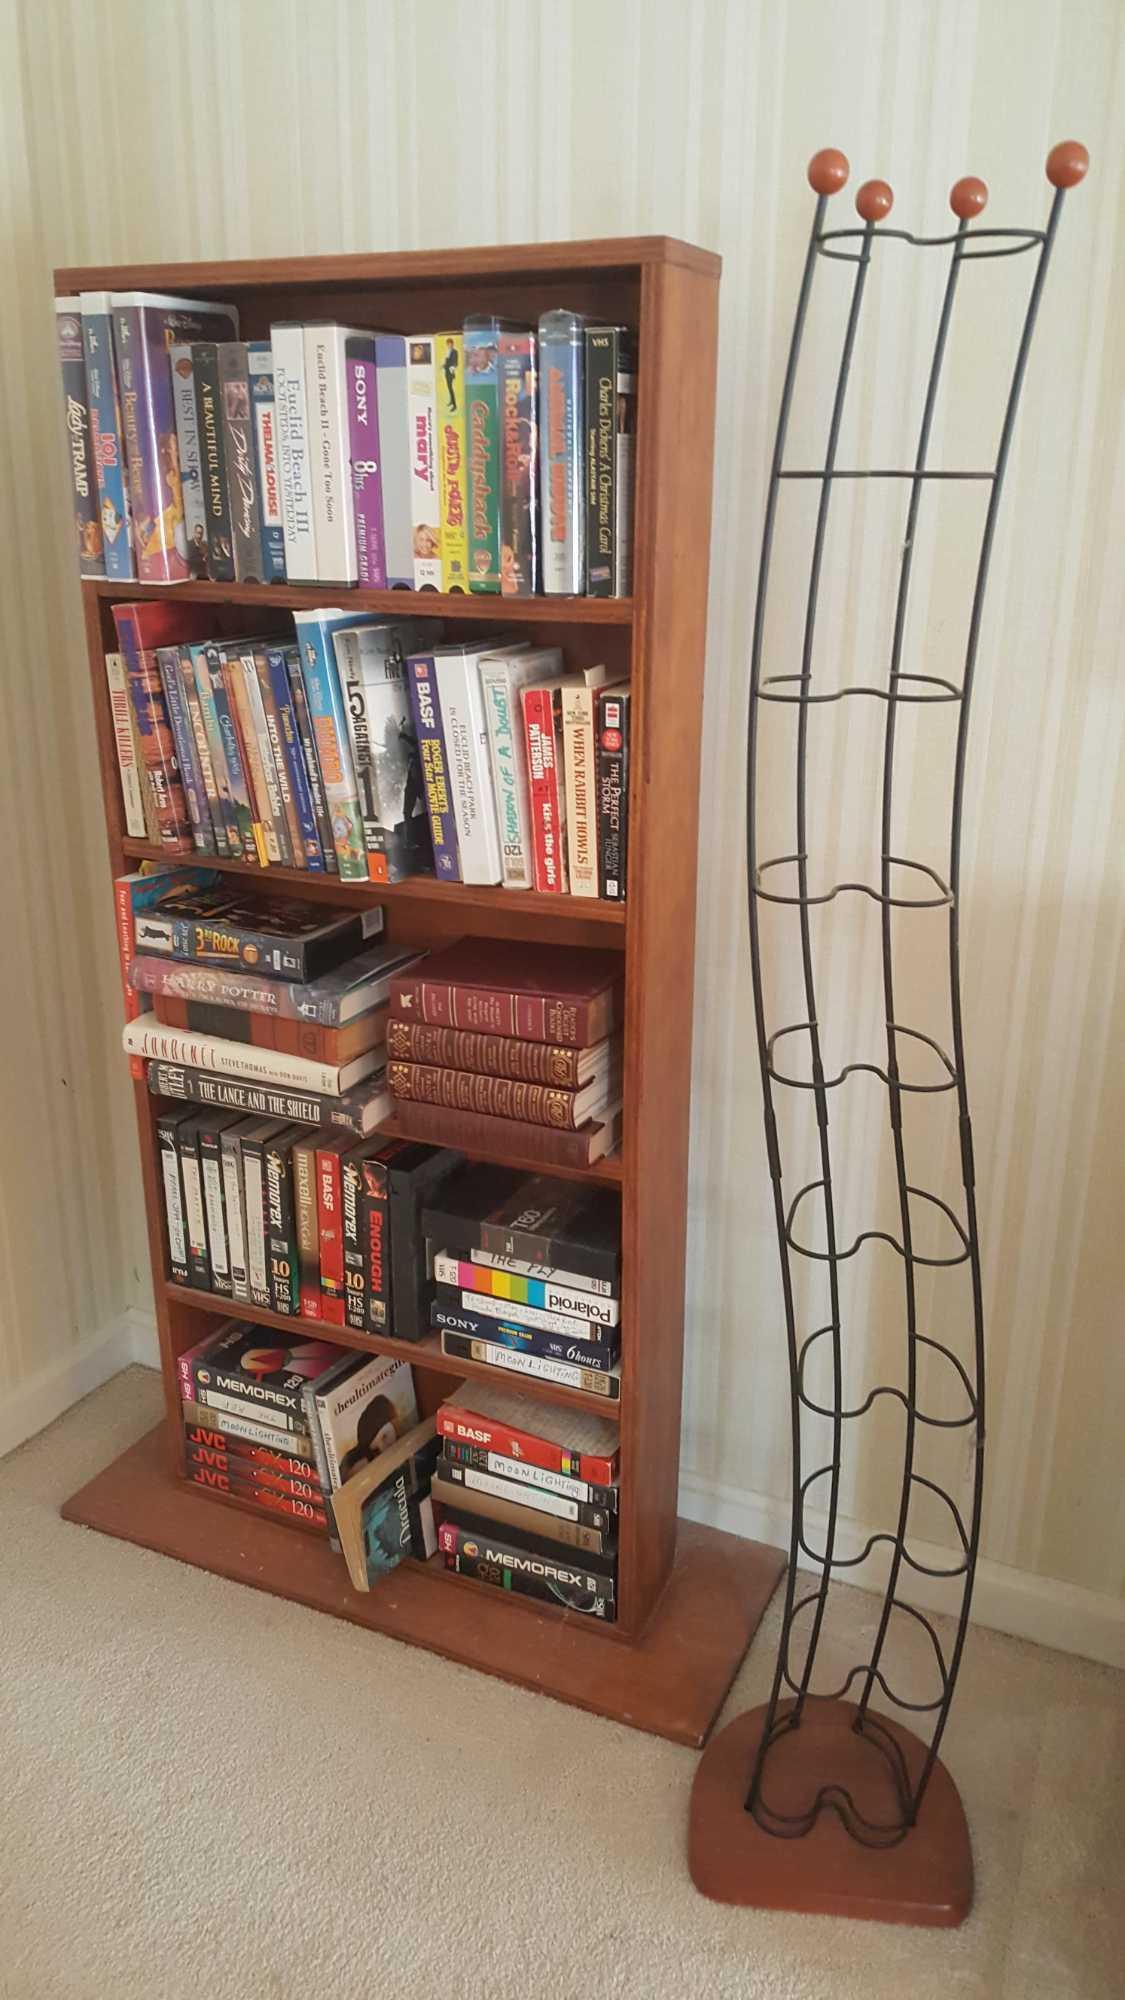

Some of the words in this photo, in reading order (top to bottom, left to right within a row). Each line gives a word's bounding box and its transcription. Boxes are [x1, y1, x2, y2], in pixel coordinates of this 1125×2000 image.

[316, 344, 327, 379] Euclid
[201, 383, 212, 392] A
[319, 383, 329, 417] Beach
[354, 365, 368, 425] SONY
[599, 377, 611, 416] Charles
[181, 388, 194, 422] BEST
[287, 379, 304, 440] Euclid
[185, 430, 197, 446] IN
[203, 397, 218, 470] BEAUTIFUL
[261, 411, 274, 464] THELMA
[414, 415, 430, 482] mary
[72, 440, 89, 497] TRAMP
[282, 445, 292, 475] INTO
[322, 440, 332, 470] Gone
[600, 464, 611, 472] A
[292, 449, 309, 503] Beach
[324, 471, 333, 493] Too
[209, 474, 223, 517] MIND
[266, 470, 278, 517] LOUISE
[326, 496, 335, 523] Soon
[600, 476, 612, 525] Christmas
[296, 511, 310, 534] III
[600, 528, 612, 554] Carol
[415, 682, 435, 729] BASF
[266, 714, 278, 743] INTO
[450, 718, 460, 755] CLOSED
[117, 726, 134, 768] KILLERS
[190, 700, 217, 800] ENCOUNTER
[271, 745, 283, 770] THE
[430, 739, 443, 773] ROGER
[529, 723, 545, 780] PATTERSON
[541, 732, 554, 768] JAMES
[573, 728, 585, 765] WHEN
[454, 757, 462, 773] FOR
[609, 762, 619, 784] THE
[277, 772, 290, 803] WILD
[427, 783, 439, 814] MOVIE
[456, 774, 466, 794] THE
[574, 770, 587, 819] RABBIT
[601, 776, 610, 814] STORM
[460, 797, 471, 837] SEASON
[467, 795, 476, 820] PARK
[608, 786, 622, 832] PERFECT
[432, 816, 444, 846] GUIDE
[576, 821, 590, 865] HOWLS
[212, 932, 240, 953] ROCK
[221, 985, 277, 1005] POTTER
[198, 1081, 217, 1100] THE
[218, 1084, 246, 1106] LANCE
[247, 1092, 267, 1111] AND
[267, 1095, 286, 1114] THE
[286, 1099, 321, 1122] SHIELD
[266, 1151, 284, 1230] Memorex
[297, 1153, 313, 1205] maxell
[322, 1174, 334, 1211] BASF
[343, 1164, 358, 1241] Memorex
[271, 1258, 290, 1278] 10
[369, 1210, 383, 1293] ENOUGH
[490, 1253, 517, 1268] THE
[528, 1263, 556, 1279] FLY
[275, 1283, 290, 1294] HS
[345, 1270, 364, 1290] 10
[347, 1295, 364, 1307] HS
[549, 1294, 612, 1323] Polaroid
[436, 1313, 479, 1332] SONY
[216, 1375, 297, 1410] MEMOREX
[284, 1375, 304, 1390] 120
[190, 1429, 227, 1450] JVC
[457, 1424, 492, 1444] BASF
[192, 1449, 228, 1471] JVC
[288, 1459, 311, 1478] 120
[194, 1469, 230, 1490] JVC
[290, 1479, 312, 1499] 120
[292, 1500, 314, 1520] 120
[393, 1475, 412, 1546] Dracula
[485, 1550, 583, 1586] MEMOREX
